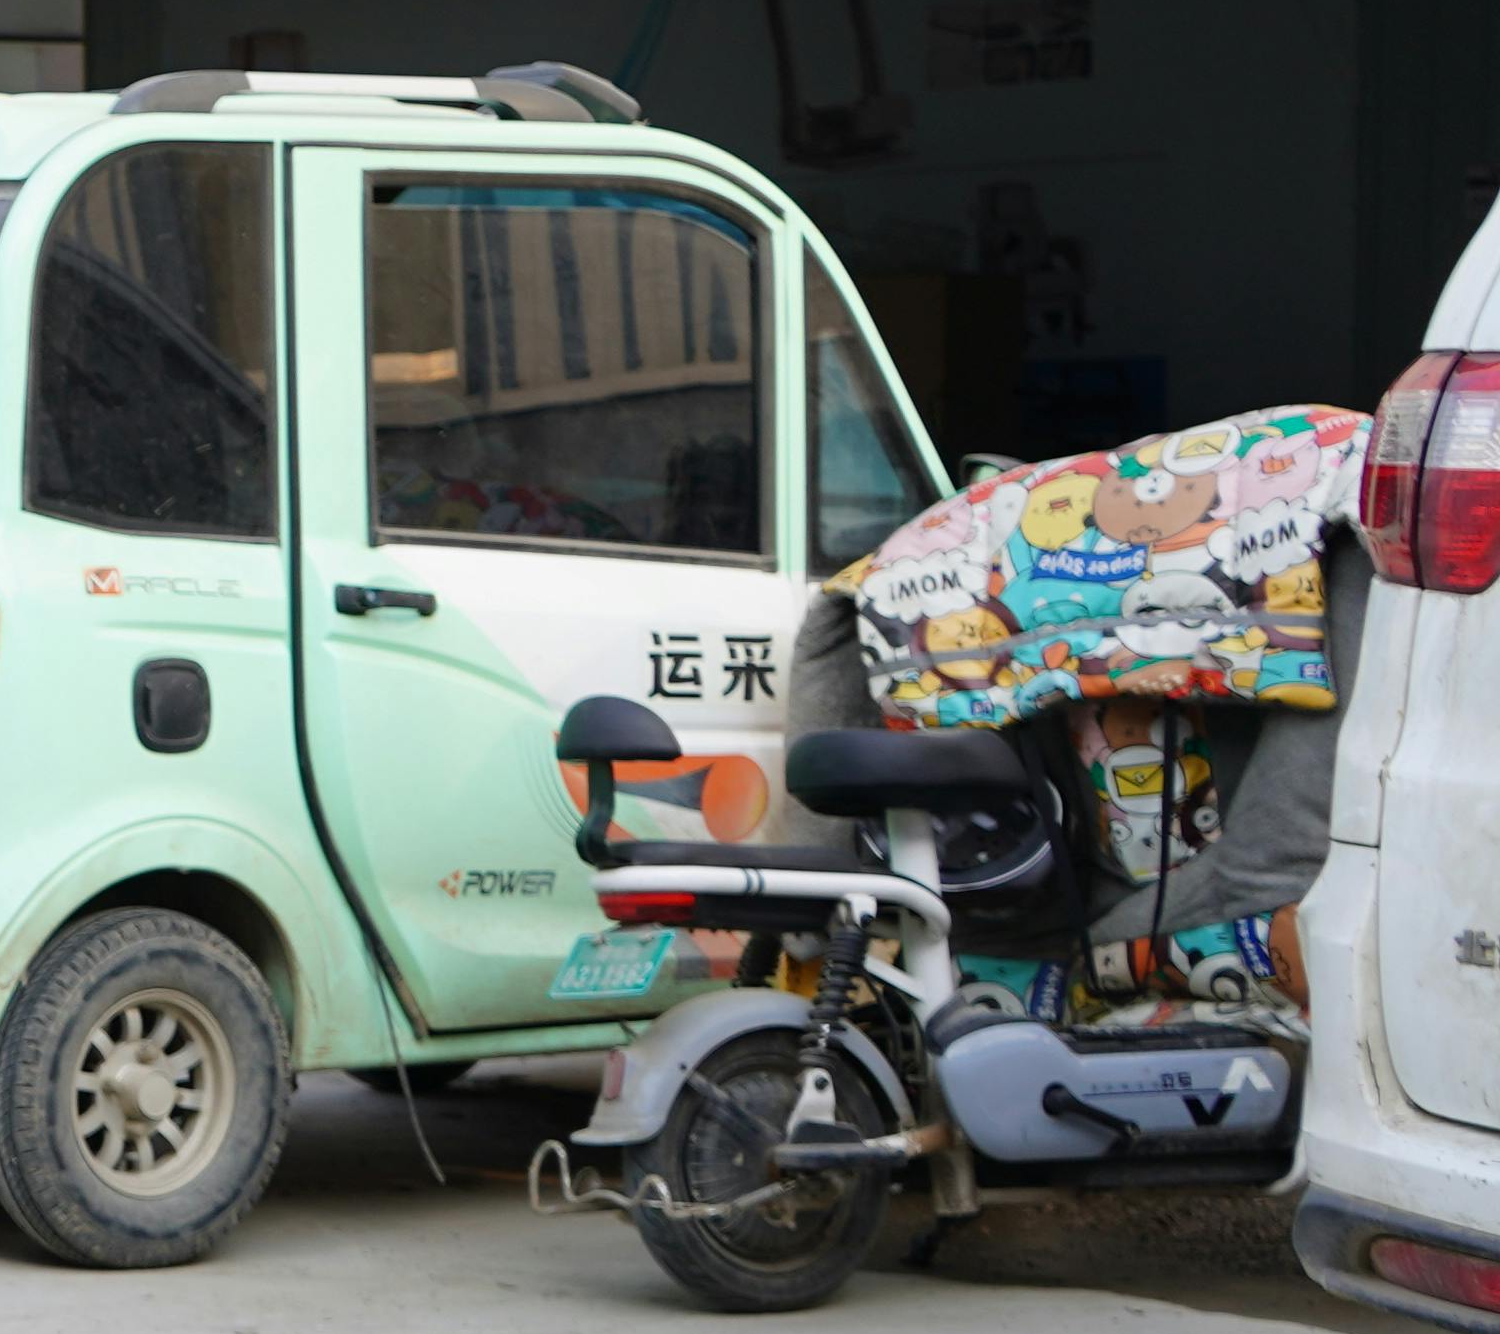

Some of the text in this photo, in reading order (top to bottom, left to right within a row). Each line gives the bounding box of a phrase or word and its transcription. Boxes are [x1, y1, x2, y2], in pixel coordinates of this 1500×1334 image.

[1039, 549, 1146, 577] Super Style
[890, 569, 963, 601] WOW!
[461, 870, 556, 896] POWER
